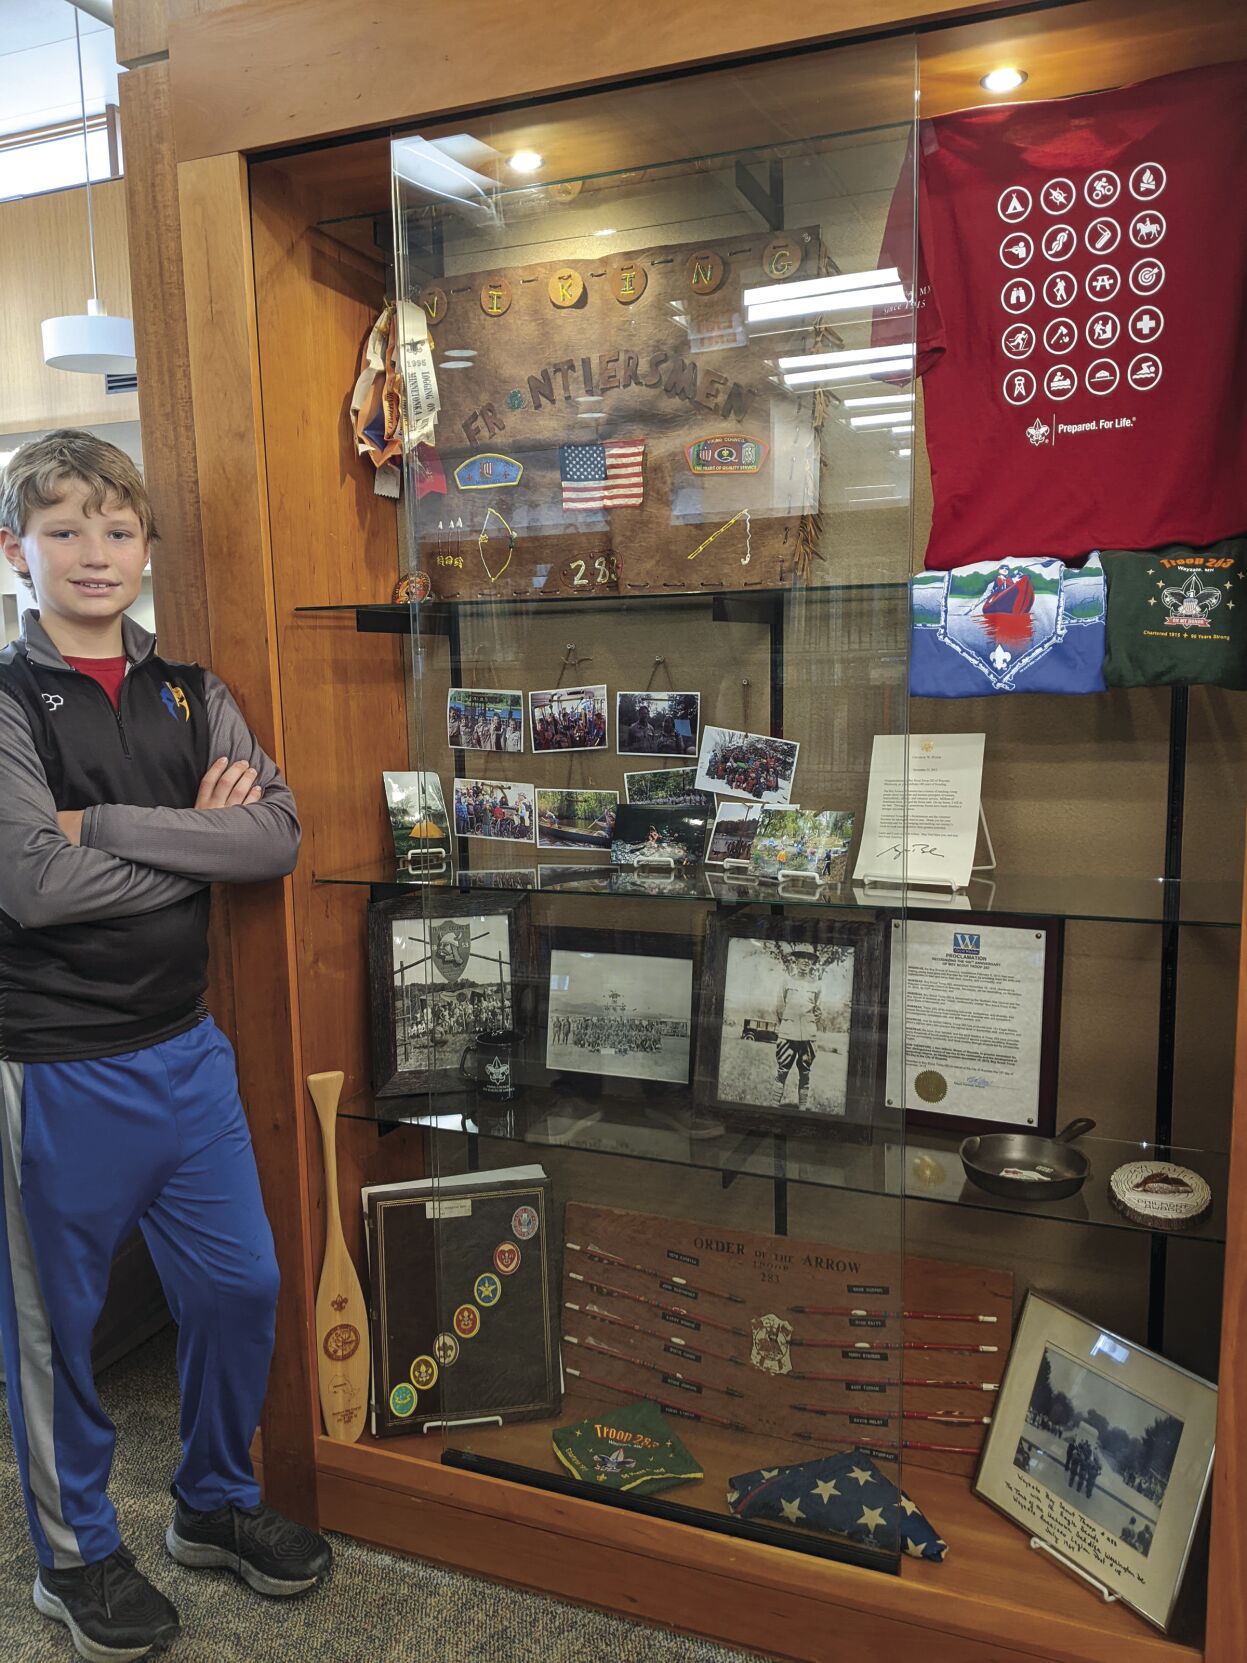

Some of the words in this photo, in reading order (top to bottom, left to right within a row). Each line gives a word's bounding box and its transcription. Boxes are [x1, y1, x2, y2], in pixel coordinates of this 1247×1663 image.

[421, 371, 434, 400] LOGGING
[1058, 421, 1098, 435] Prepared.
[1100, 419, 1113, 429] For
[1160, 557, 1205, 569] Troop
[945, 953, 987, 961] PROCLAMATION
[693, 1237, 745, 1255] ORDER
[802, 1254, 861, 1274] ARROW
[594, 1424, 632, 1442] Troop
